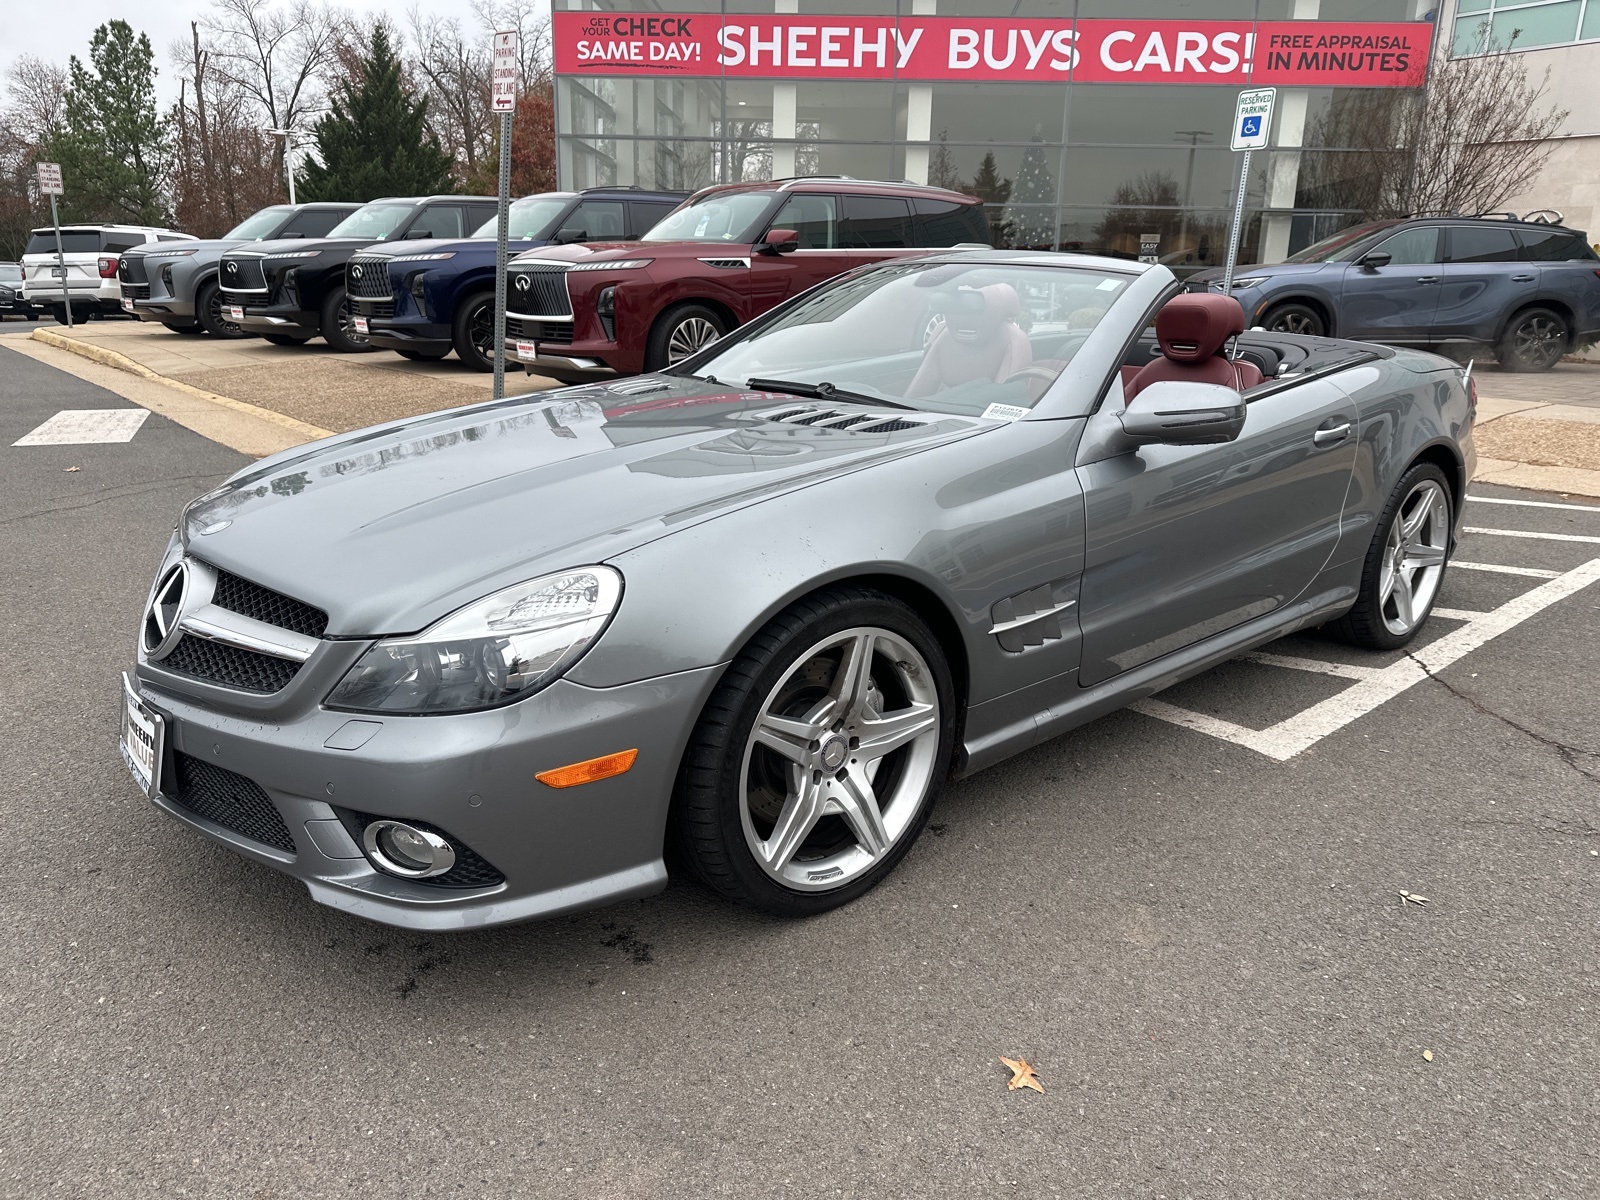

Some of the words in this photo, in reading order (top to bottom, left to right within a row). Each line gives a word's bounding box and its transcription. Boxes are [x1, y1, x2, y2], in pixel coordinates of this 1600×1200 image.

[590, 18, 610, 27] GET
[613, 17, 692, 37] CHECK
[582, 27, 610, 36] YOUR
[502, 35, 509, 45] NO
[1269, 34, 1314, 48] FREE
[1316, 35, 1411, 50] APPRAISAL
[495, 47, 515, 58] PARKING
[576, 40, 644, 61] SAME
[649, 42, 701, 61] DAY!
[716, 25, 924, 69] SHEEHY
[948, 28, 1081, 71] BUYS
[1100, 29, 1257, 74] CARS!
[1267, 51, 1292, 70] IN
[1296, 52, 1410, 72] MINUTES
[494, 68, 515, 79] STANDING
[494, 82, 502, 95] FIRE
[503, 82, 514, 94] LANE
[1240, 95, 1272, 105] RESERVED
[1241, 105, 1268, 115] PARKING
